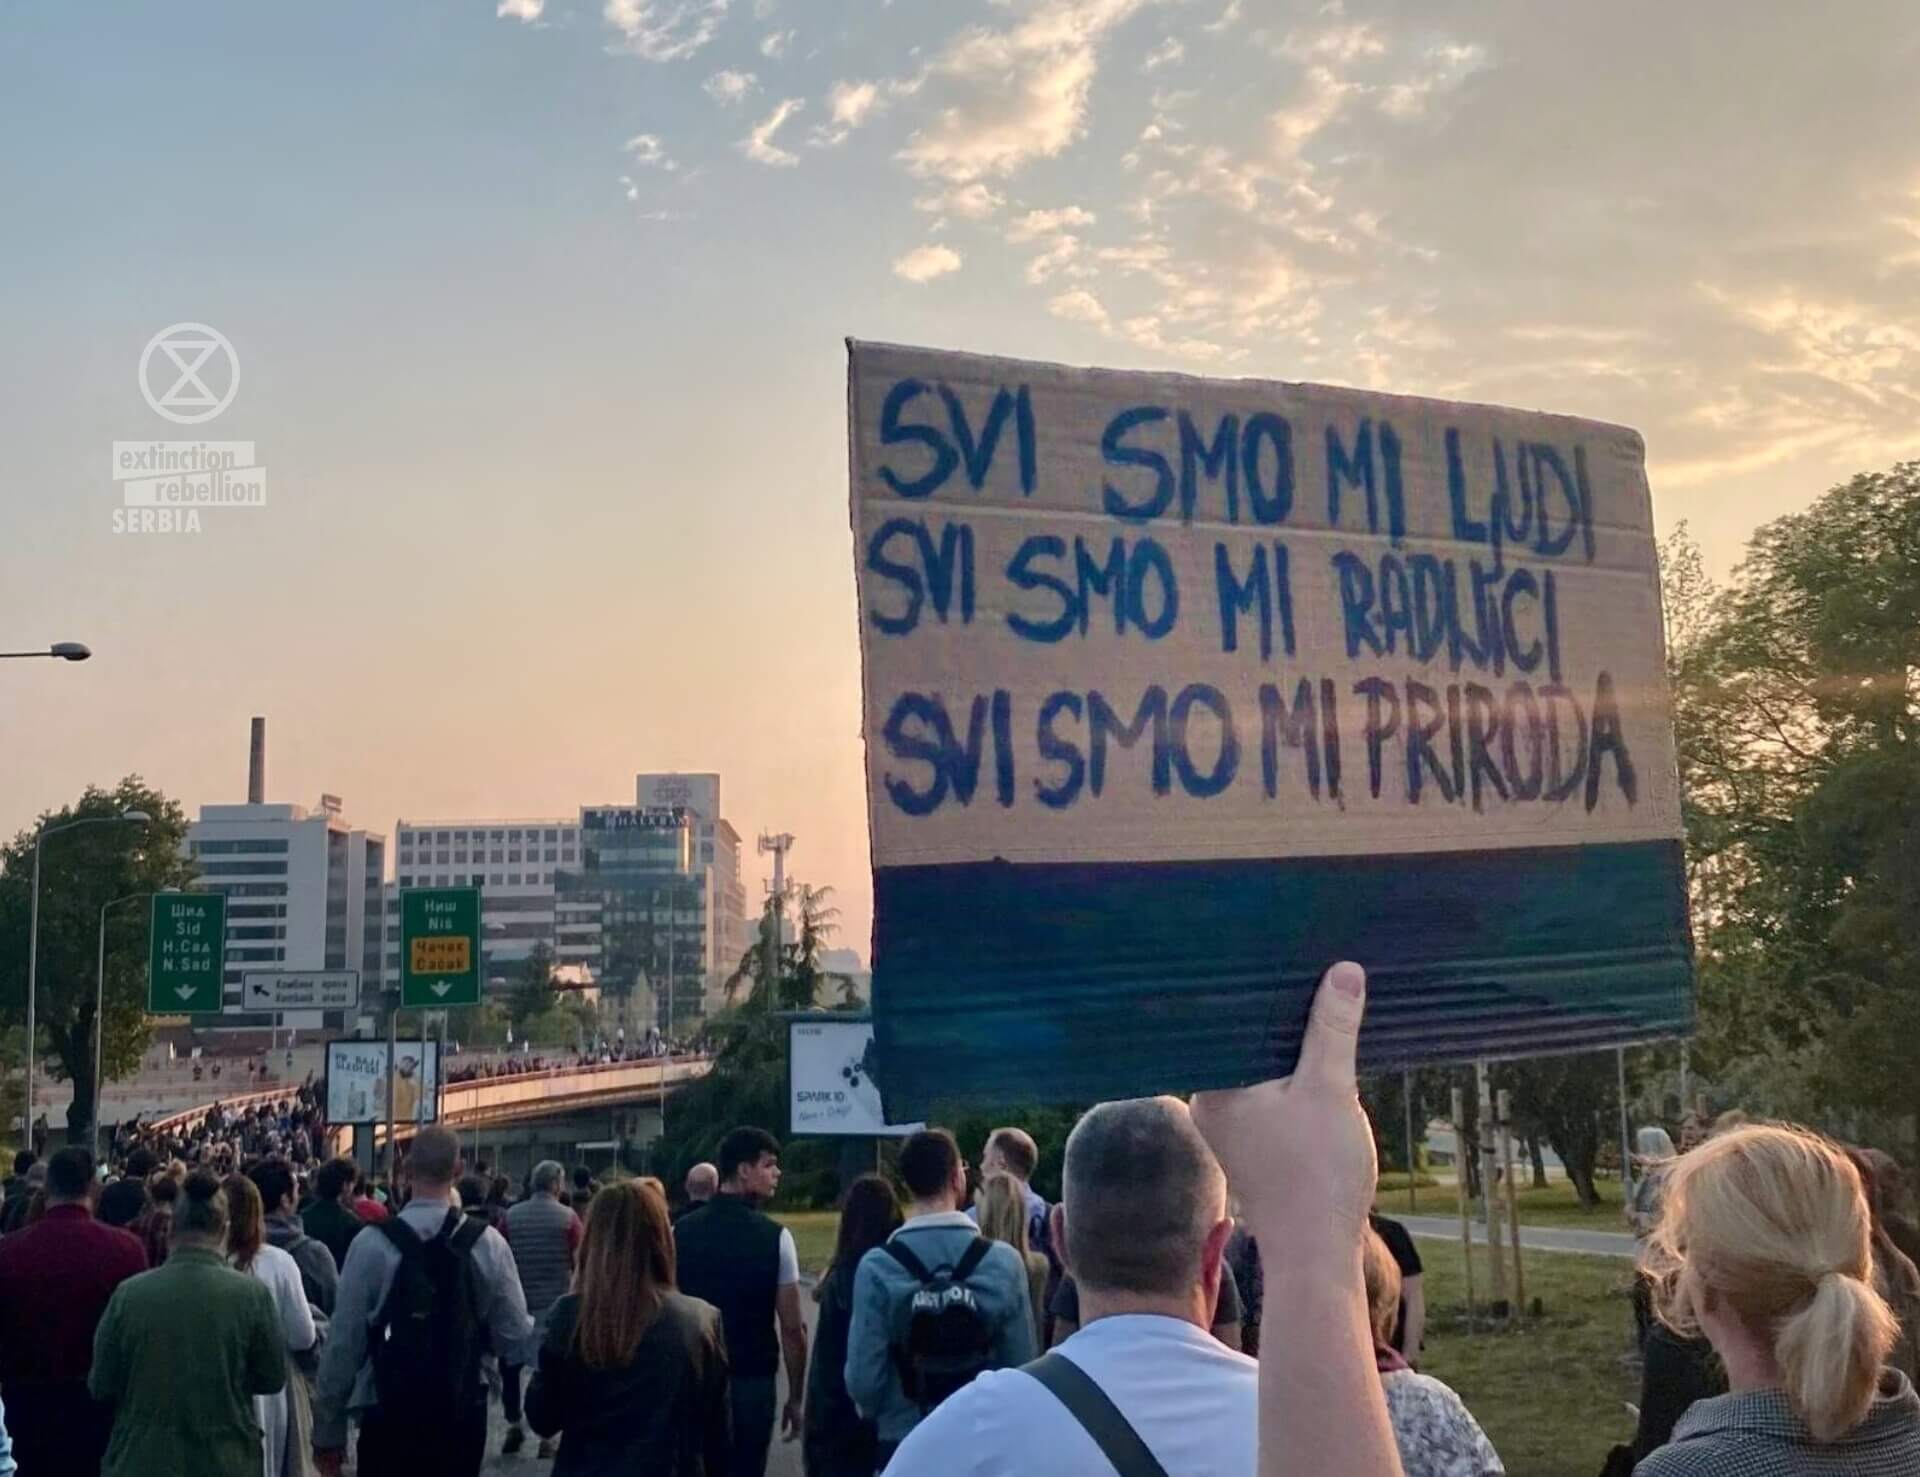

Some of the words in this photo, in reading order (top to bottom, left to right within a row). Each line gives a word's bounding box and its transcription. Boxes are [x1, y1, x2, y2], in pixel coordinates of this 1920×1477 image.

[877, 377, 1038, 497] SVI
[1101, 405, 1293, 525] SMO
[1325, 418, 1406, 550] MI
[1444, 426, 1596, 582] LJUDI
[865, 518, 976, 636] SVI
[1005, 534, 1180, 643] SMO
[1215, 540, 1296, 662] MI
[882, 688, 1015, 816] SVI
[1033, 682, 1242, 811] SMO
[1258, 677, 1345, 811] MI
[1352, 671, 1638, 816] PRIRODA
